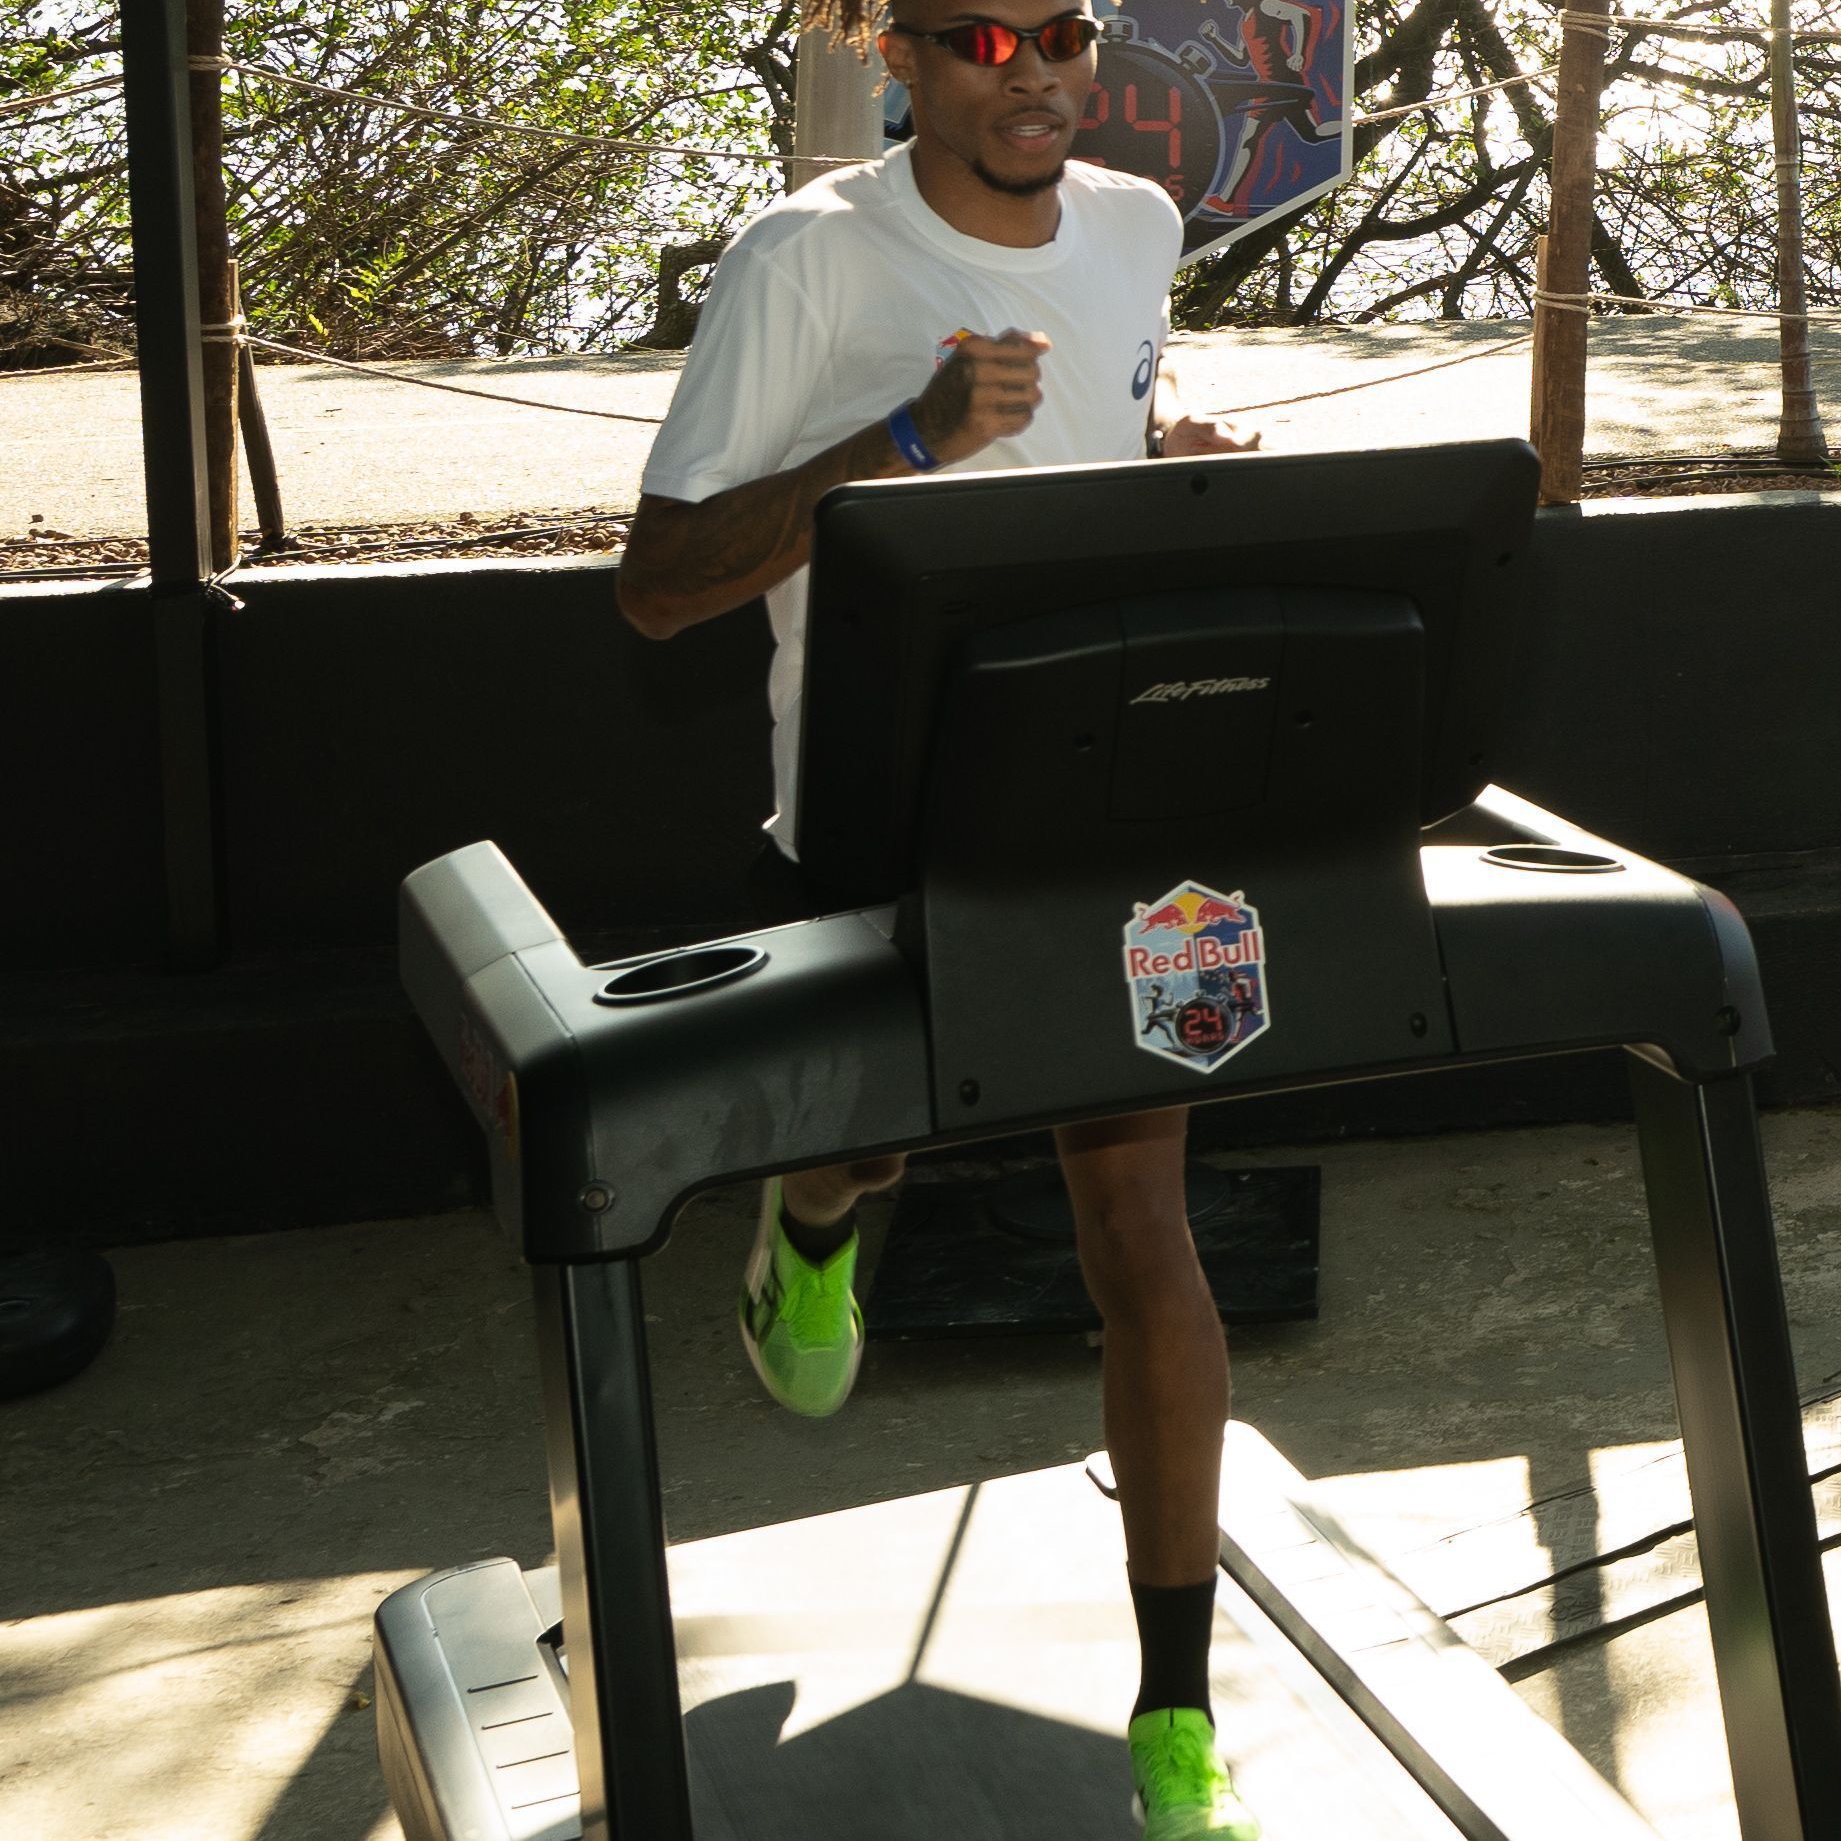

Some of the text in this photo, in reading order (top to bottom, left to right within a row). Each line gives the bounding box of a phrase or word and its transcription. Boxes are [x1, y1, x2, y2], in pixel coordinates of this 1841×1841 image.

[1129, 931, 1260, 977] Red Bull
[1184, 1006, 1223, 1035] 24
